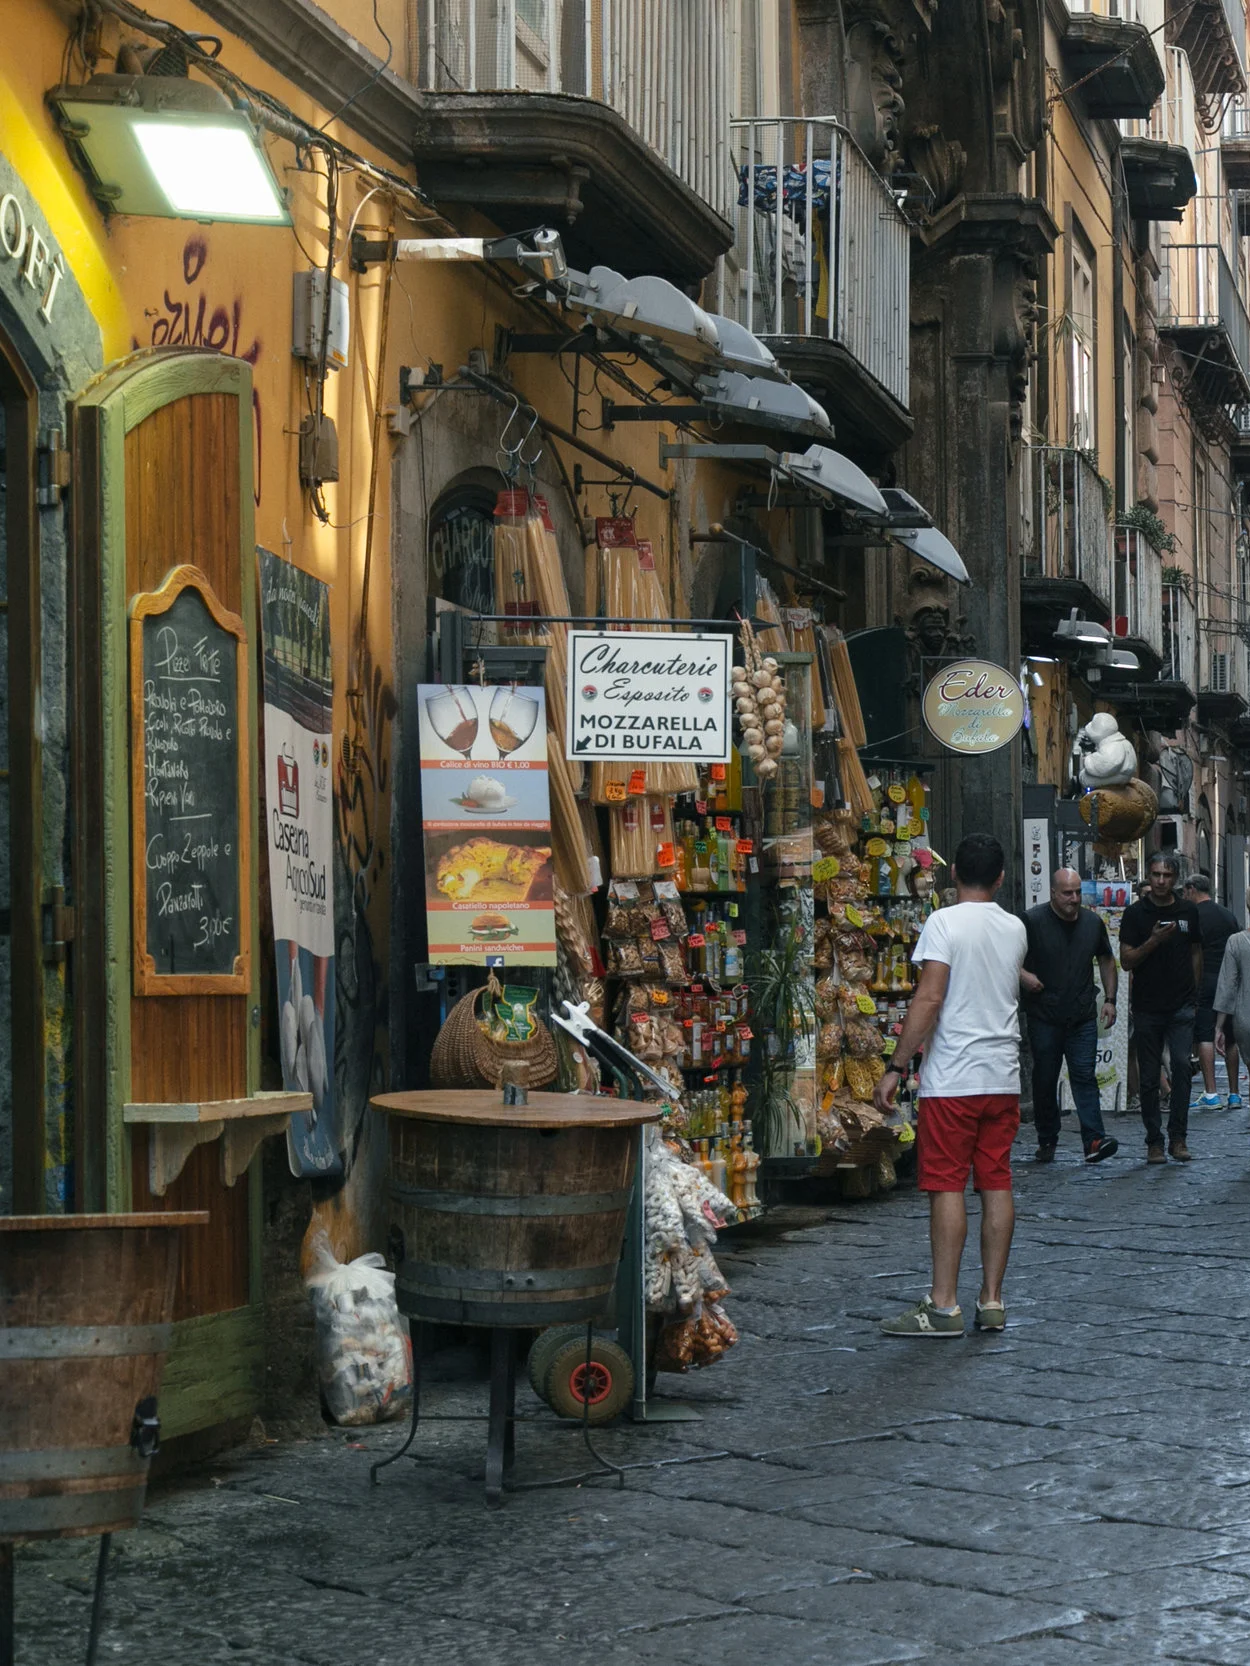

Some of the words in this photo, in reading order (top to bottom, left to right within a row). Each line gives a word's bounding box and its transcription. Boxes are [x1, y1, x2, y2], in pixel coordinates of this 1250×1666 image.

[580, 644, 718, 676] Charcuterie
[604, 678, 690, 707] Esposito
[938, 669, 1013, 702] Eder
[938, 702, 1013, 717] Mozzarella
[580, 714, 717, 731] MOZZARELLA
[968, 717, 982, 729] di
[595, 734, 615, 748] DI
[623, 735, 702, 750] BUFALA
[950, 728, 1000, 746] Bufala
[440, 760, 460, 769] Calice
[463, 760, 472, 769] di
[473, 761, 489, 769] vino
[492, 761, 505, 769] BIO
[181, 833, 218, 871] Zeppole
[224, 844, 231, 855] e
[452, 902, 487, 910] Casatiello
[489, 902, 529, 911] napoletano
[460, 944, 482, 952] Panini
[485, 944, 524, 952] sandwiches
